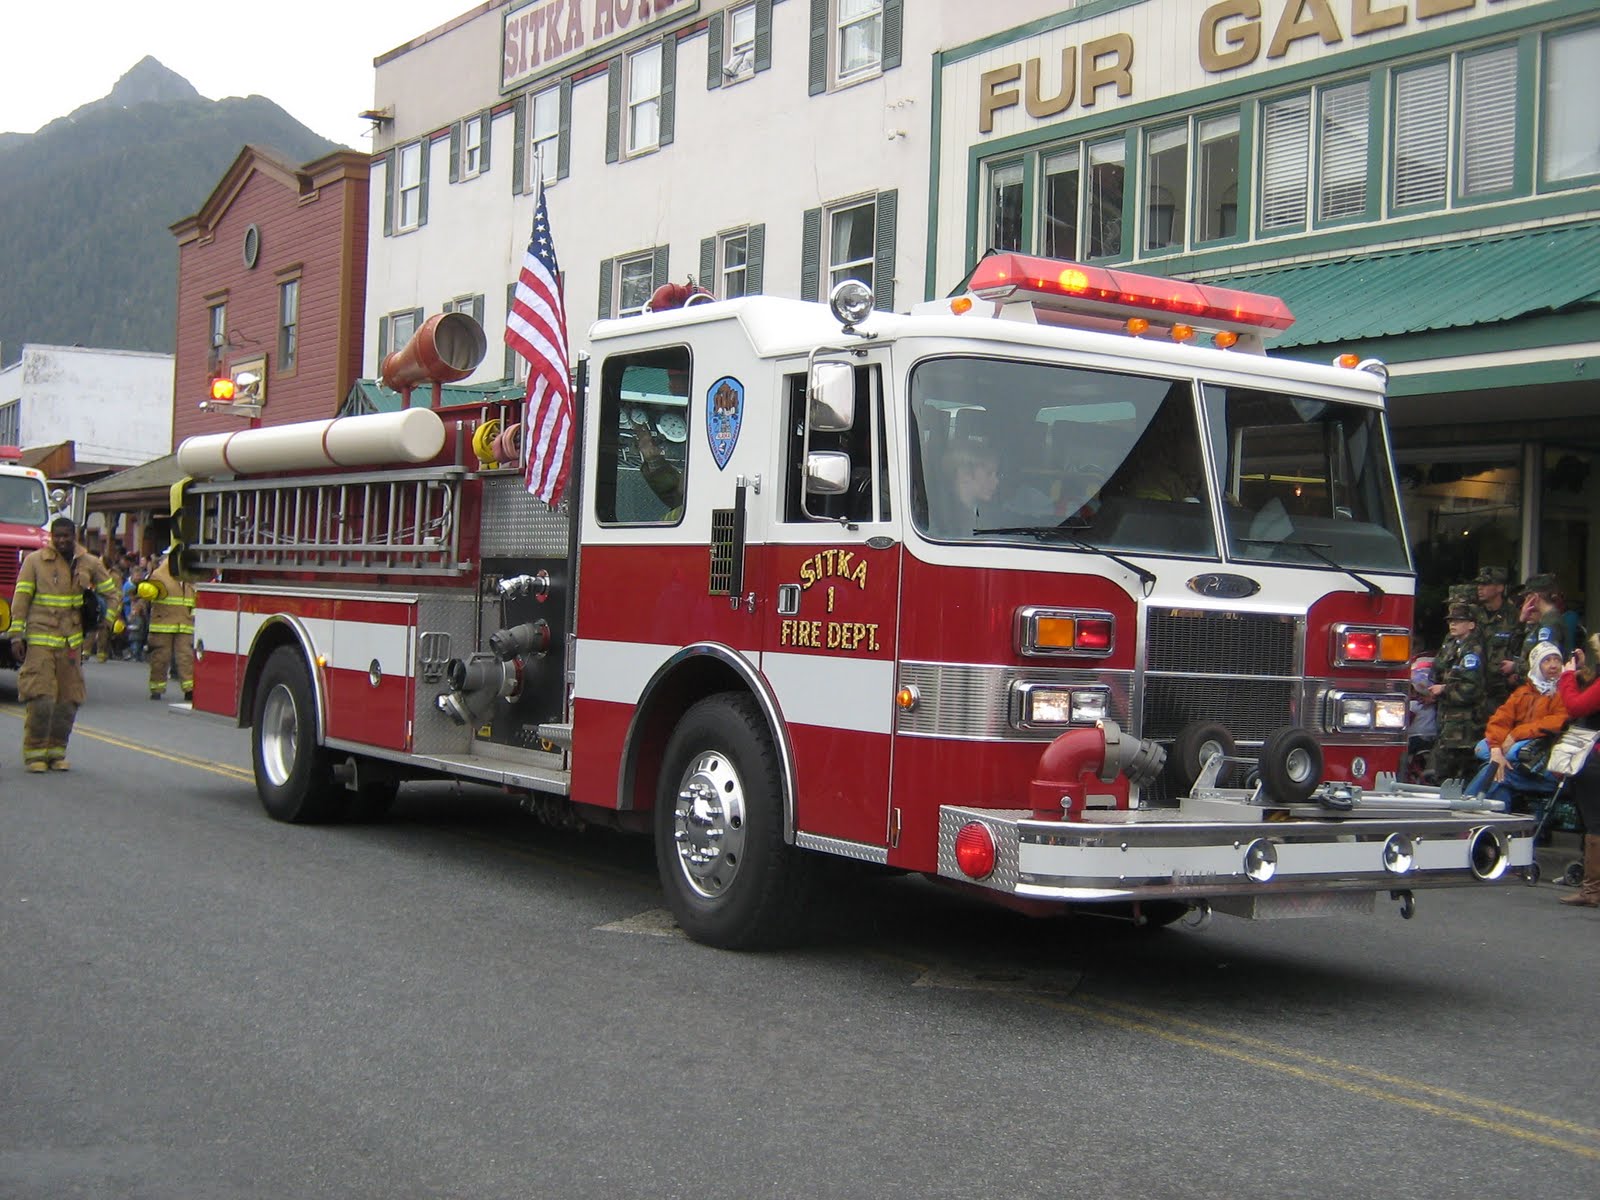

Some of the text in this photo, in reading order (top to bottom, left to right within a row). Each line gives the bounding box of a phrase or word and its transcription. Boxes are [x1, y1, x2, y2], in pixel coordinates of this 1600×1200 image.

[504, 0, 585, 79] SITKA
[979, 32, 1134, 134] FUR
[800, 549, 868, 590] SITKA
[781, 619, 880, 651] FIRE DEPT.
